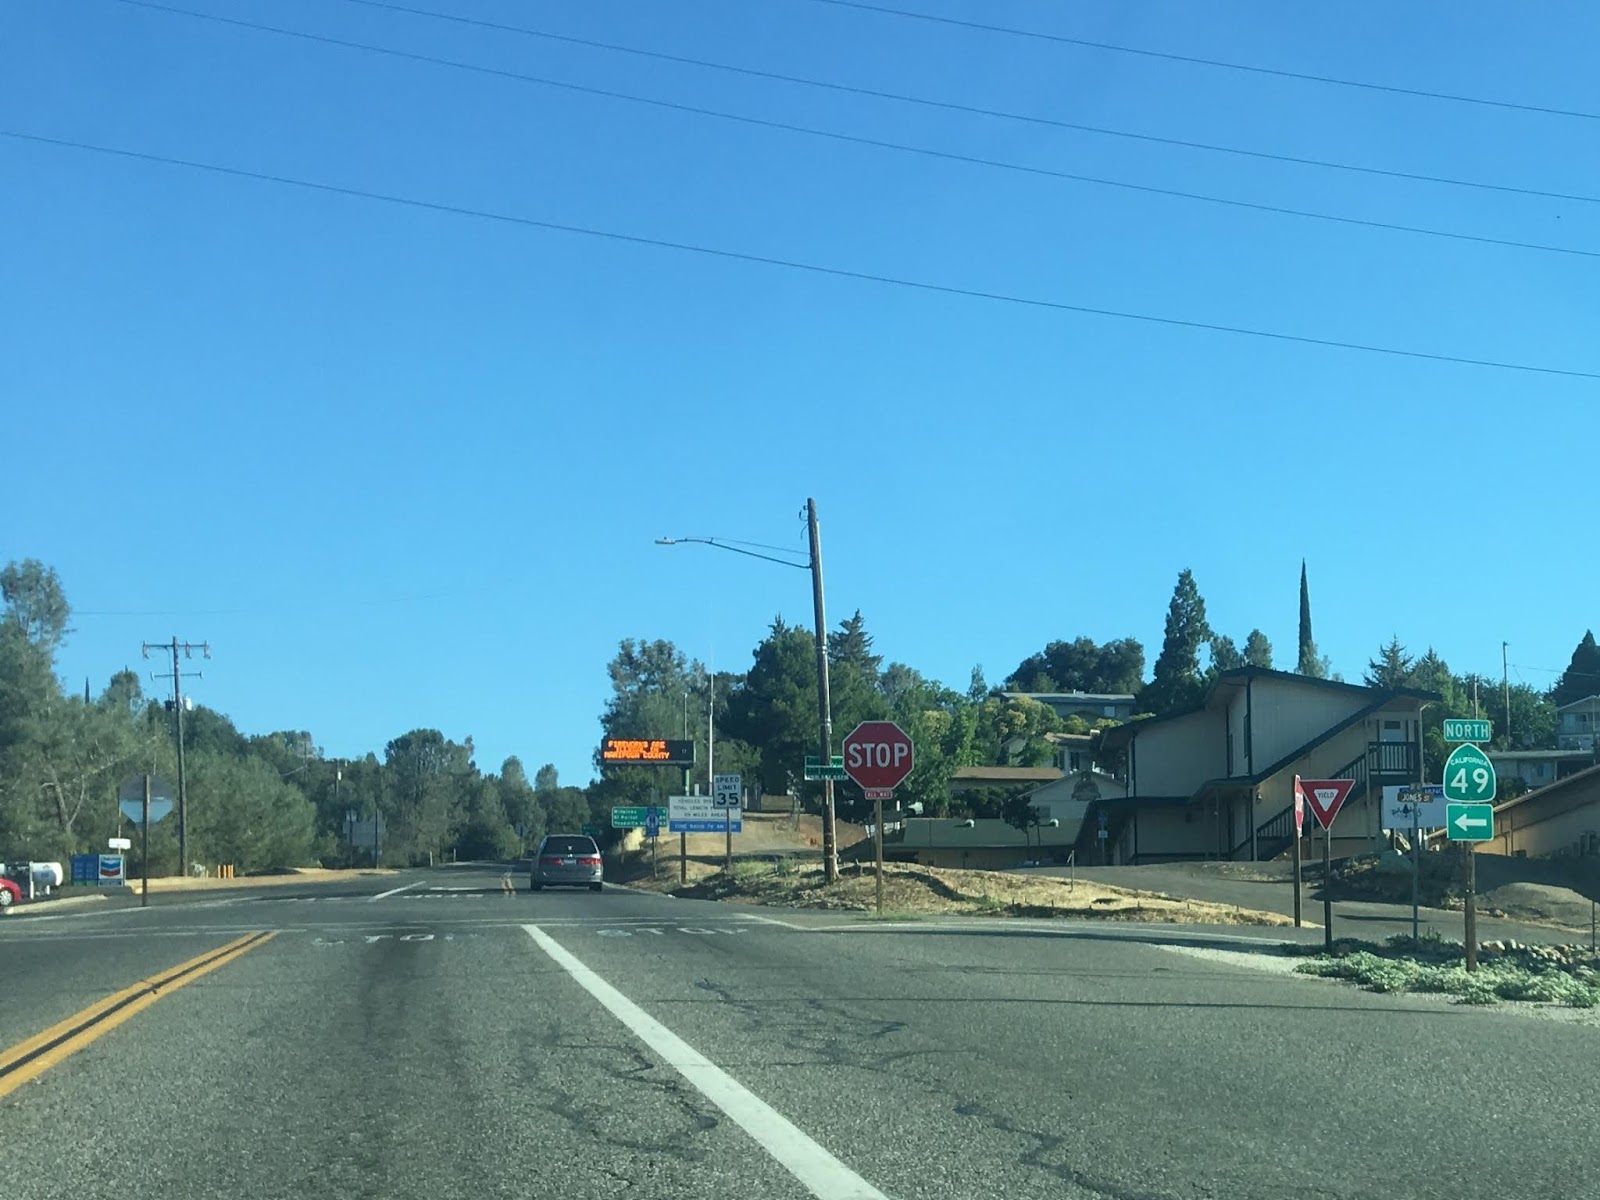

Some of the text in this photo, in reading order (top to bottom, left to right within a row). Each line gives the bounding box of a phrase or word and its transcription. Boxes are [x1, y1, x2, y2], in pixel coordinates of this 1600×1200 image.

[1446, 724, 1488, 738] NORTH
[848, 742, 909, 767] STOP
[1450, 756, 1488, 767] CALIFORNIA
[1450, 768, 1489, 794] 49
[717, 792, 739, 806] 35
[1401, 793, 1422, 801] JONES
